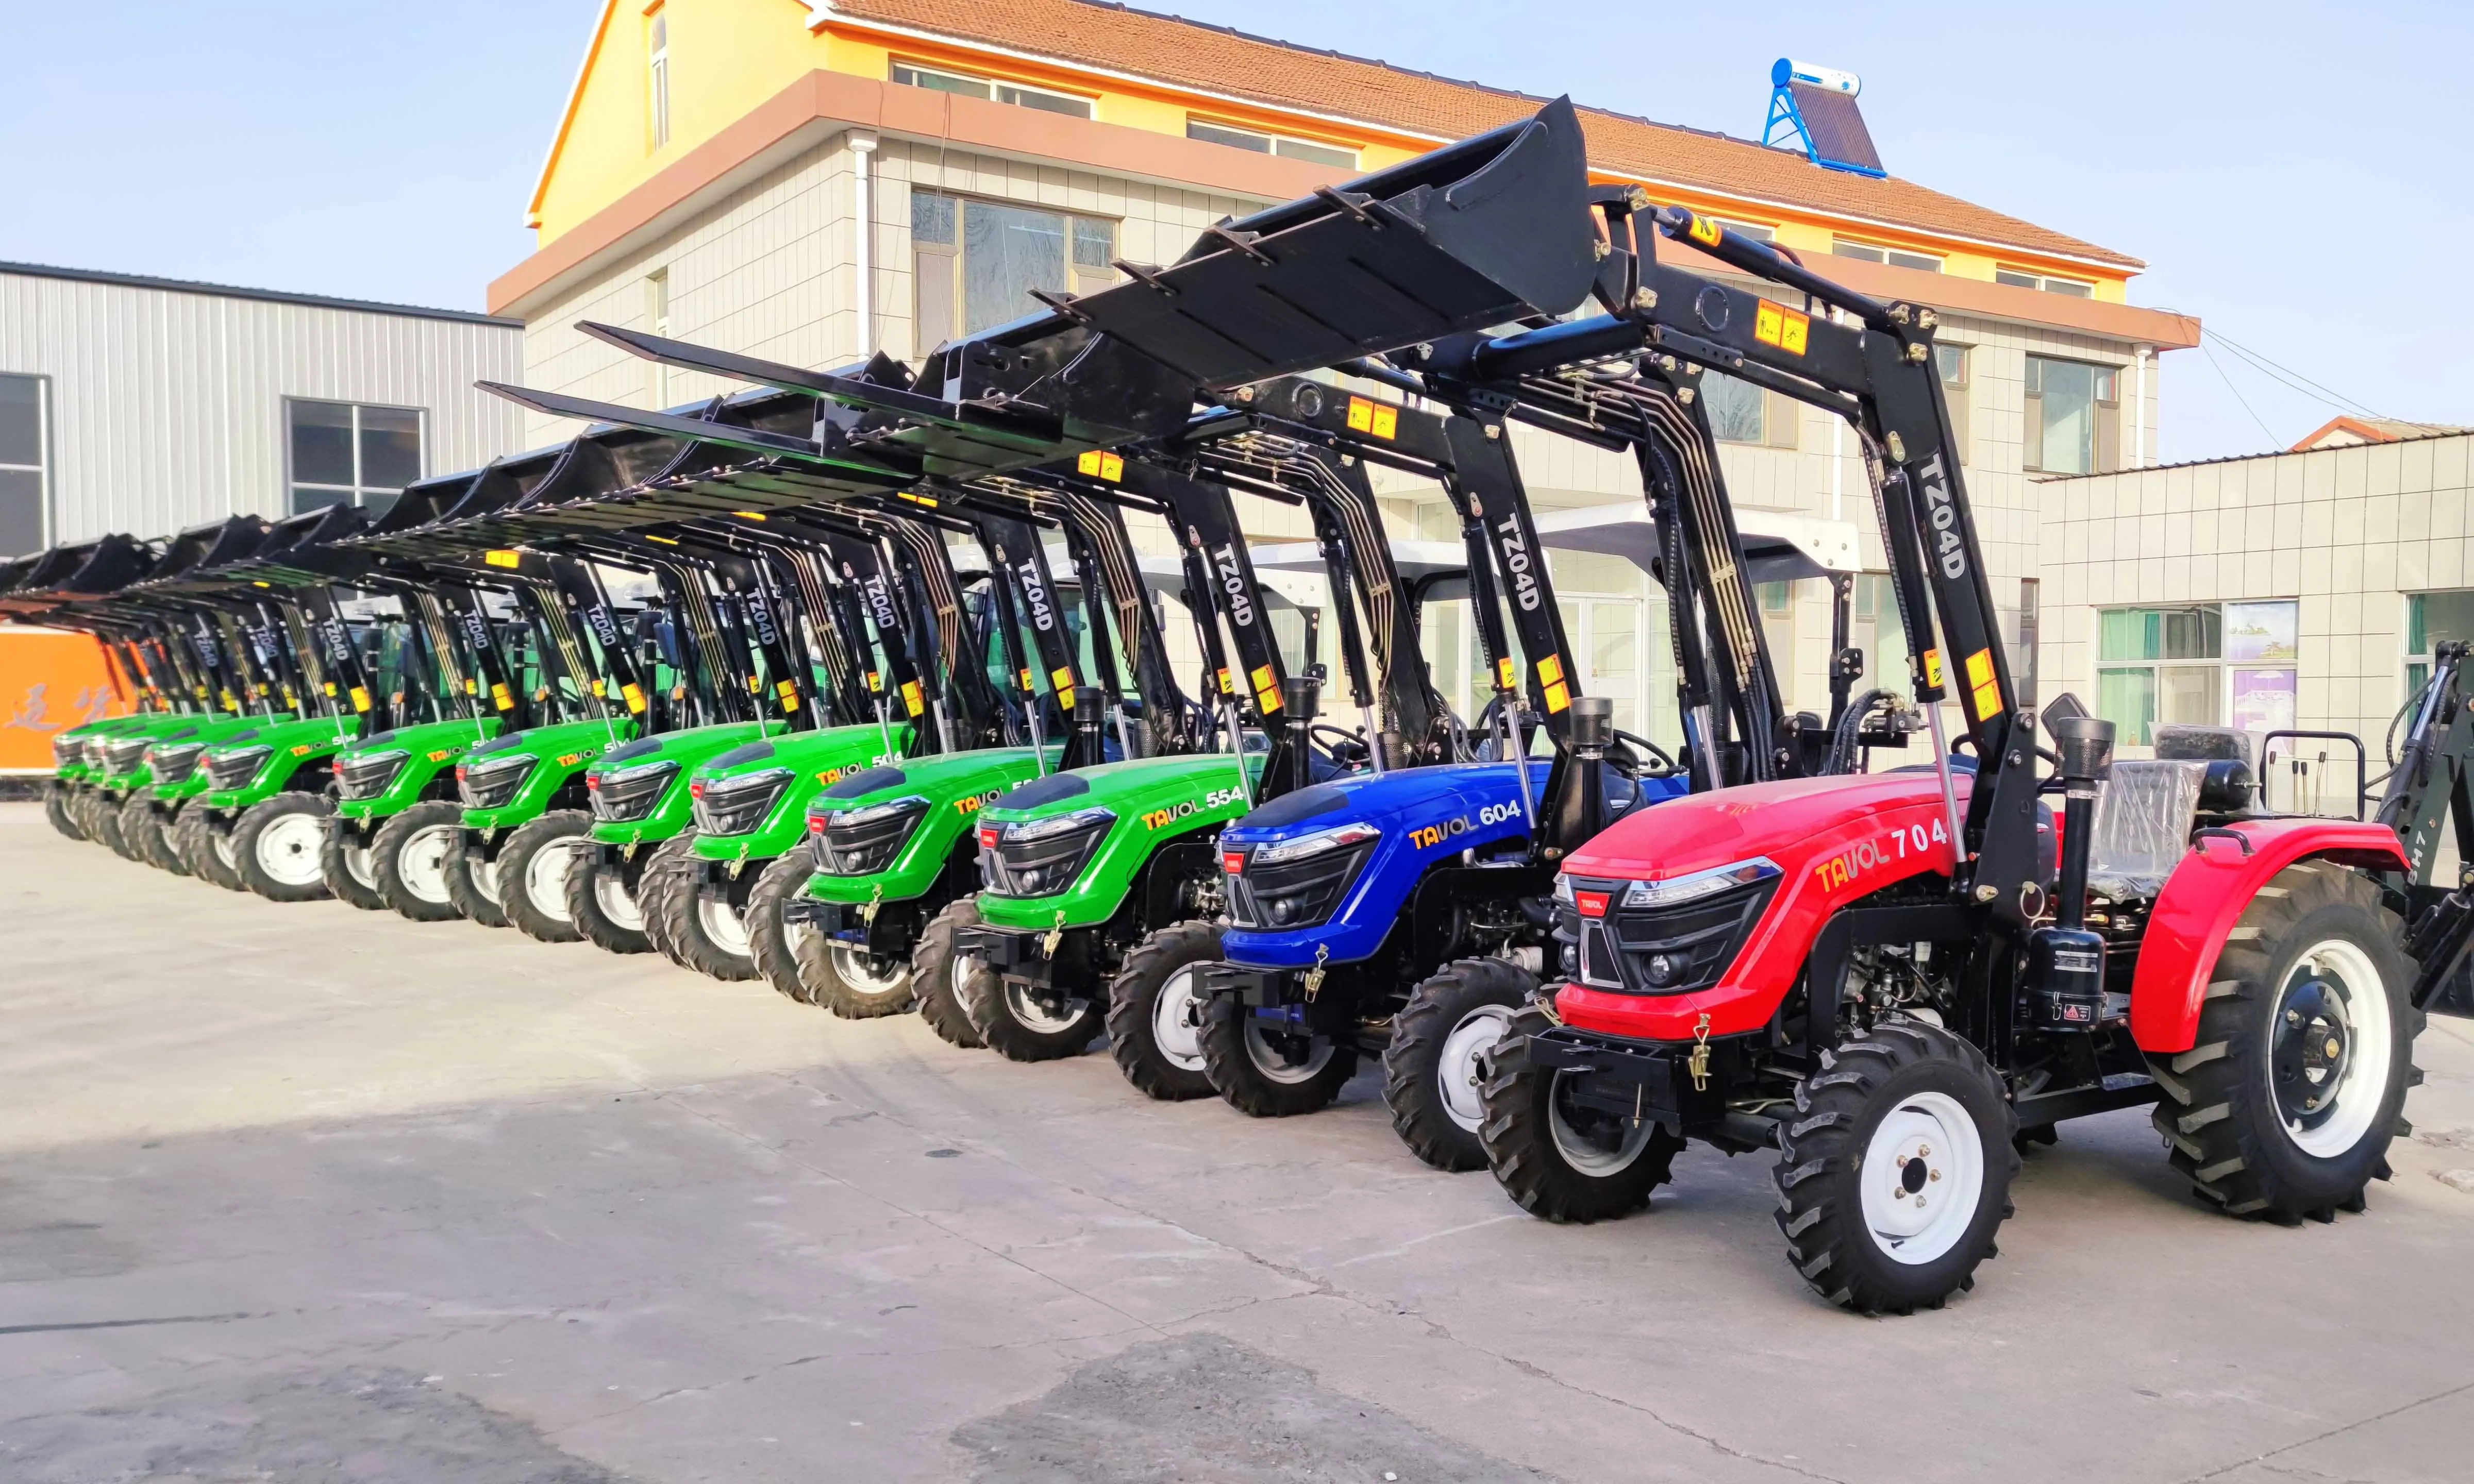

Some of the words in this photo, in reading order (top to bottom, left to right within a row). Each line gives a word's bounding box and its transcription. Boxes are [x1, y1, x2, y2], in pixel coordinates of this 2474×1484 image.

[1920, 453, 1965, 579] TZ04D
[1215, 543, 1253, 626] TZ04D
[1498, 513, 1539, 611] TZ04D
[746, 587, 775, 644] TZ04D
[865, 575, 895, 628] TZ04D
[1019, 558, 1052, 630] TZ04D
[323, 617, 348, 660] TZ04D
[464, 610, 488, 648] TZ04D
[588, 603, 616, 646] TZ04D
[816, 762, 870, 786] TAVOL
[1141, 799, 1205, 831] TAVOL
[1206, 785, 1244, 808] 554
[1409, 815, 1479, 849] TAVOL
[1480, 800, 1521, 824] 604
[1815, 838, 1890, 893] TAVOL
[1891, 818, 1947, 857] 704
